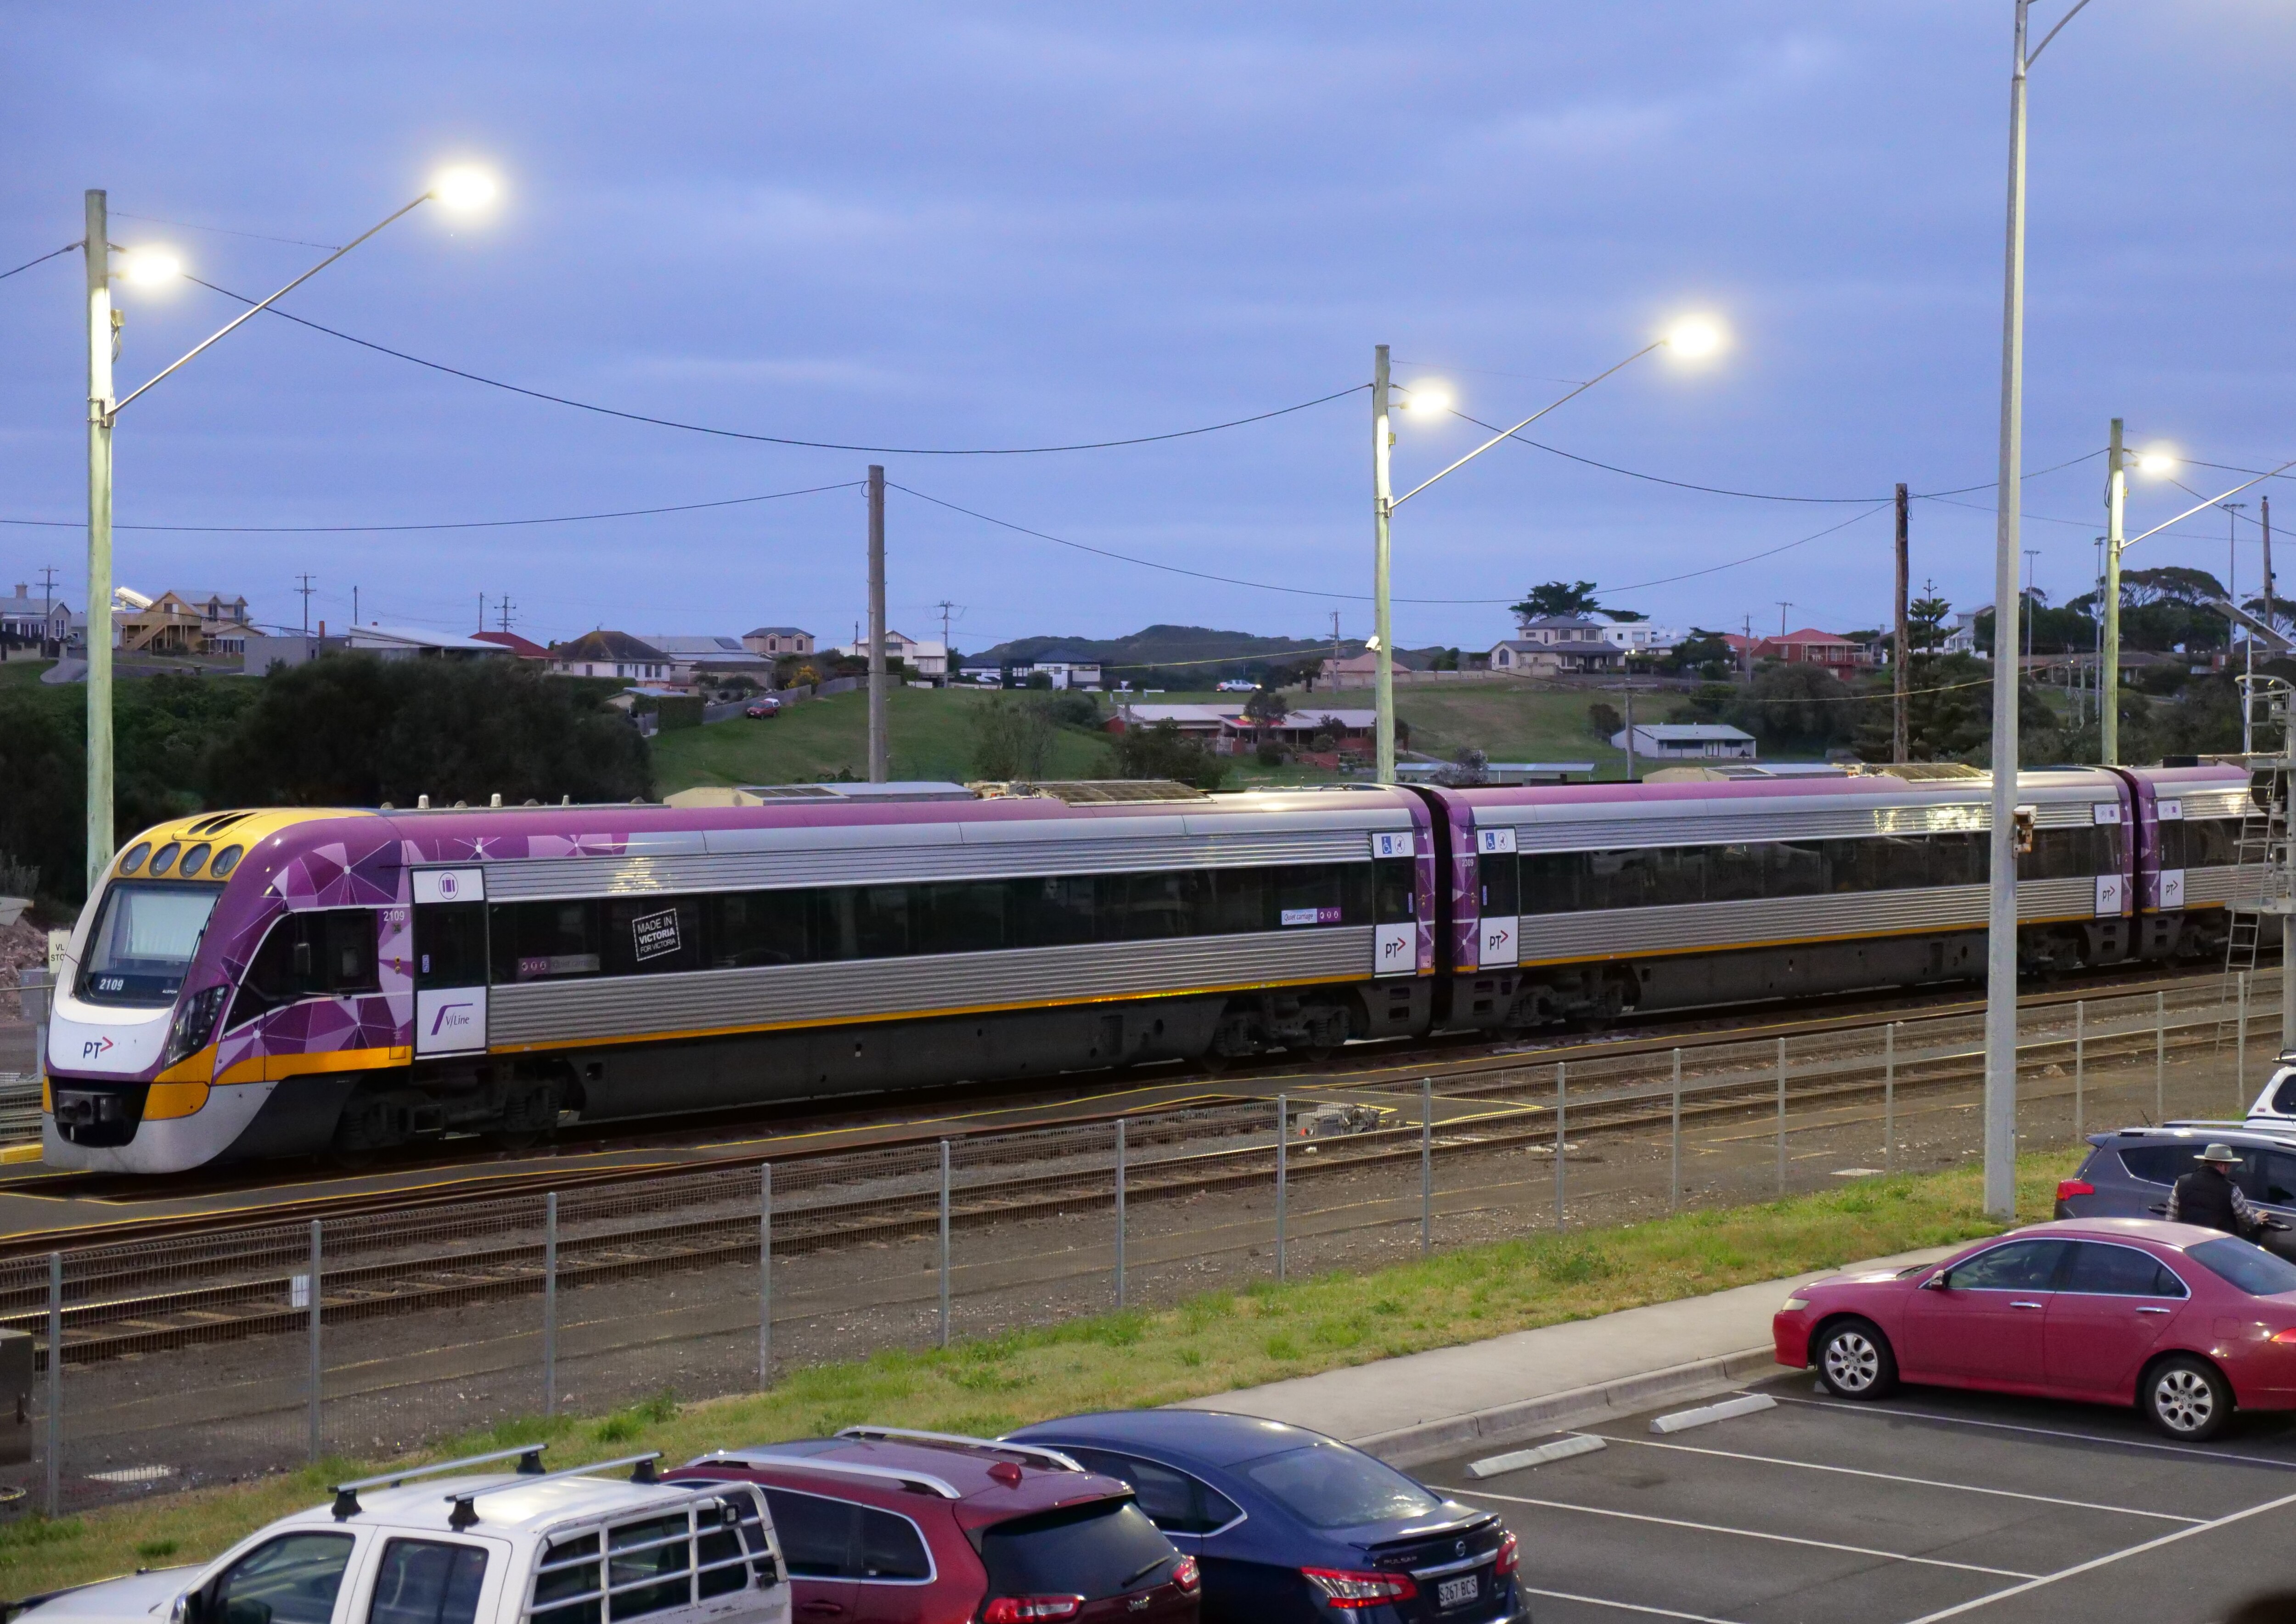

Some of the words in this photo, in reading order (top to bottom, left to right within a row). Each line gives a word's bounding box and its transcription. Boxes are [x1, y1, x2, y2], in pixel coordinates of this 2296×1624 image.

[383, 910, 405, 922] 2109
[1284, 913, 1296, 922] Quiet
[637, 918, 662, 934] MADE
[664, 916, 672, 927] IN
[639, 927, 675, 944] VICTORIA
[1490, 935, 1501, 950] PT
[640, 945, 652, 954] FOR
[652, 938, 676, 950] VICTORIA
[1385, 943, 1398, 959] PT
[99, 978, 124, 990] 2109
[446, 1011, 470, 1029] V/Line
[83, 1041, 102, 1059] PT
[1461, 1579, 1477, 1596] BCS
